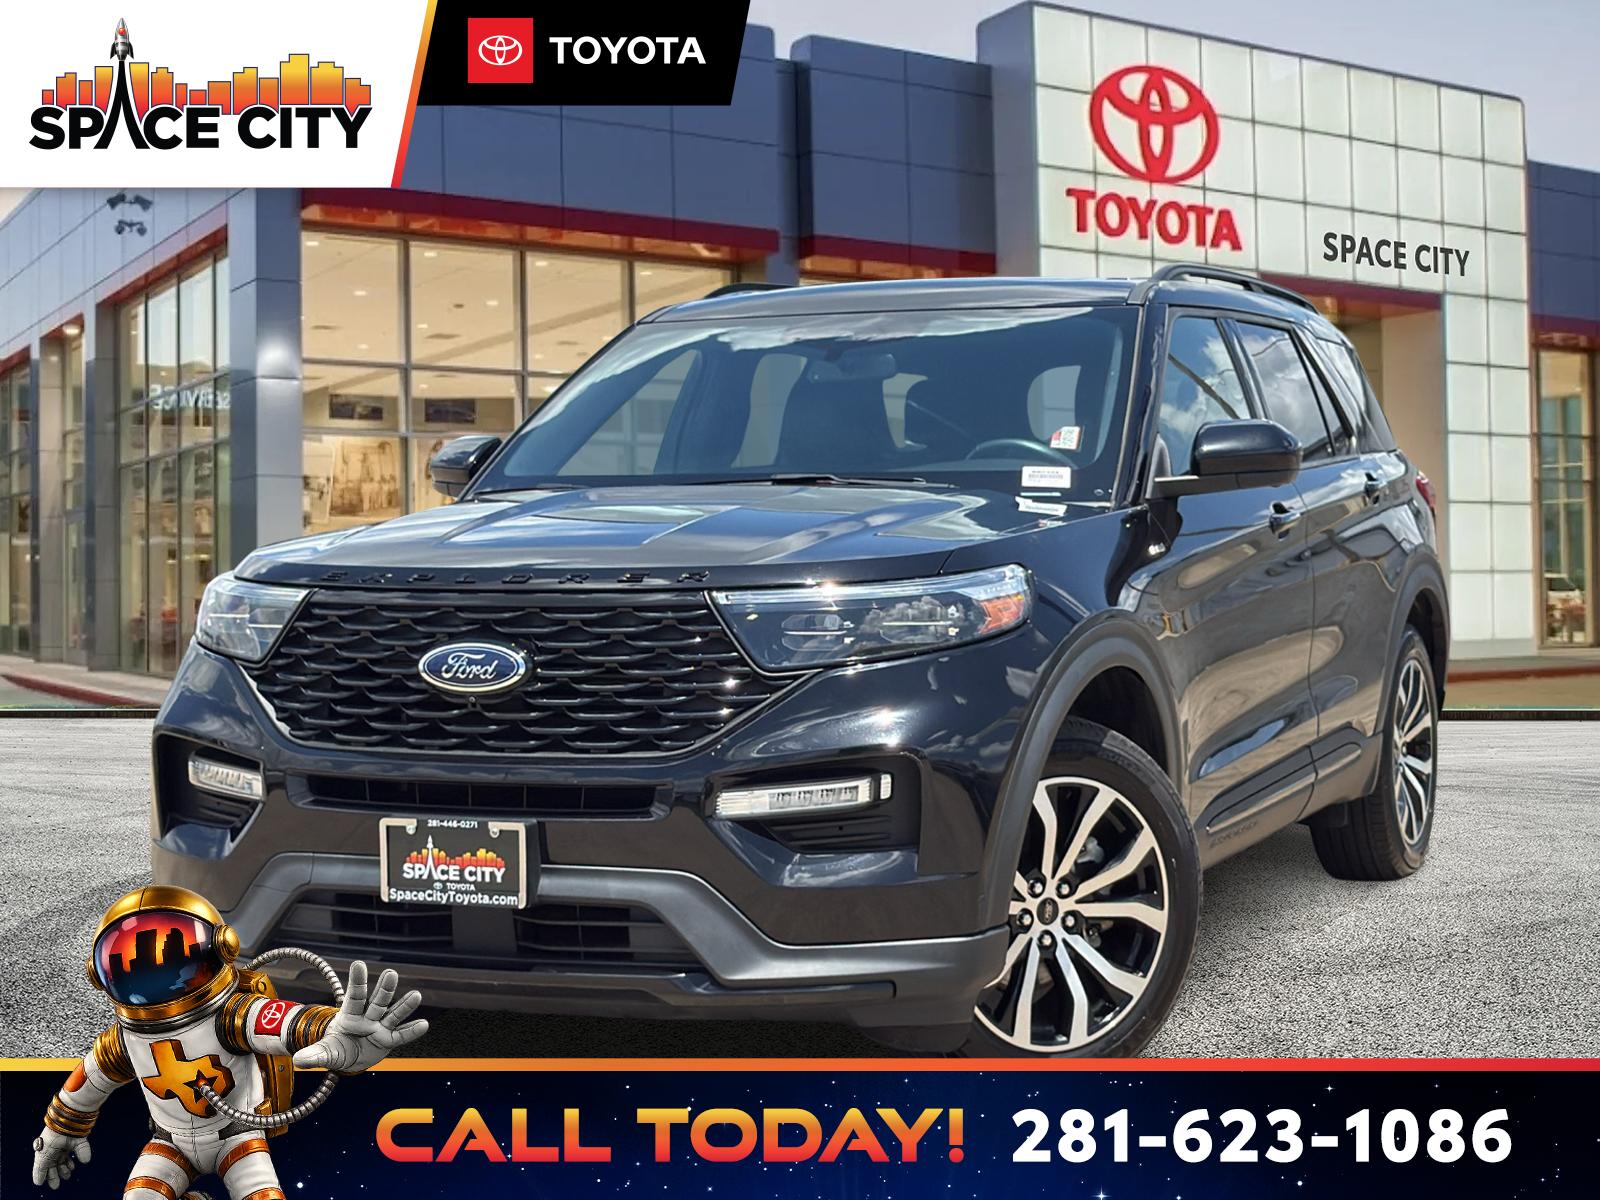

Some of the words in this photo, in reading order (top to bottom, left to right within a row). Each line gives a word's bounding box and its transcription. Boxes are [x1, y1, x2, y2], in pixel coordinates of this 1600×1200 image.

[1066, 187, 1243, 252] TOYOTA
[1322, 231, 1407, 270] SPACE
[1414, 243, 1470, 277] CITY
[319, 570, 712, 585] EXPLORER
[441, 652, 499, 681] Ford
[402, 863, 460, 880] SPACE
[464, 866, 505, 883] CITY
[389, 887, 519, 906] SpaceCityToyota.com
[446, 882, 476, 891] TOYOTA
